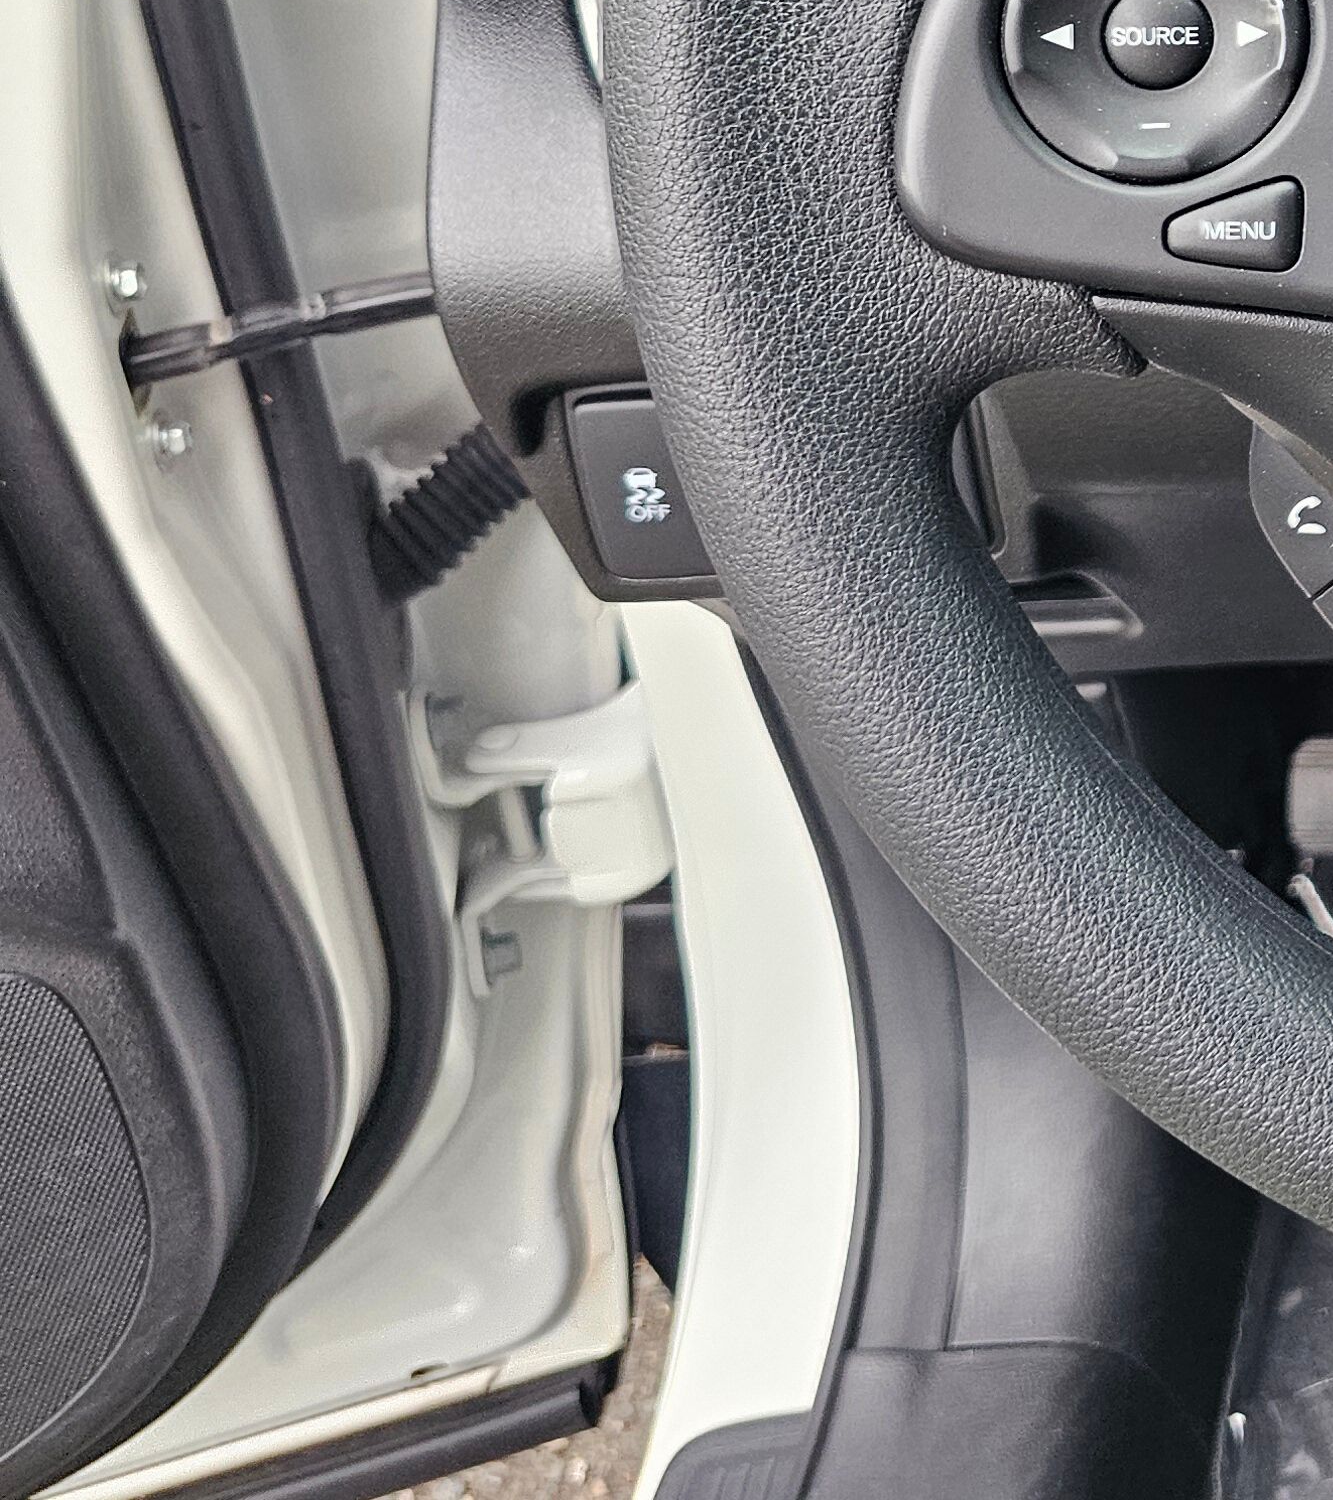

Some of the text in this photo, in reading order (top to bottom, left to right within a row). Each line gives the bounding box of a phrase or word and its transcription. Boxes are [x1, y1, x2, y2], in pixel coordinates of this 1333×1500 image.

[1110, 26, 1200, 47] SOURCE
[1203, 220, 1277, 241] MENU
[624, 503, 672, 524] OFF
